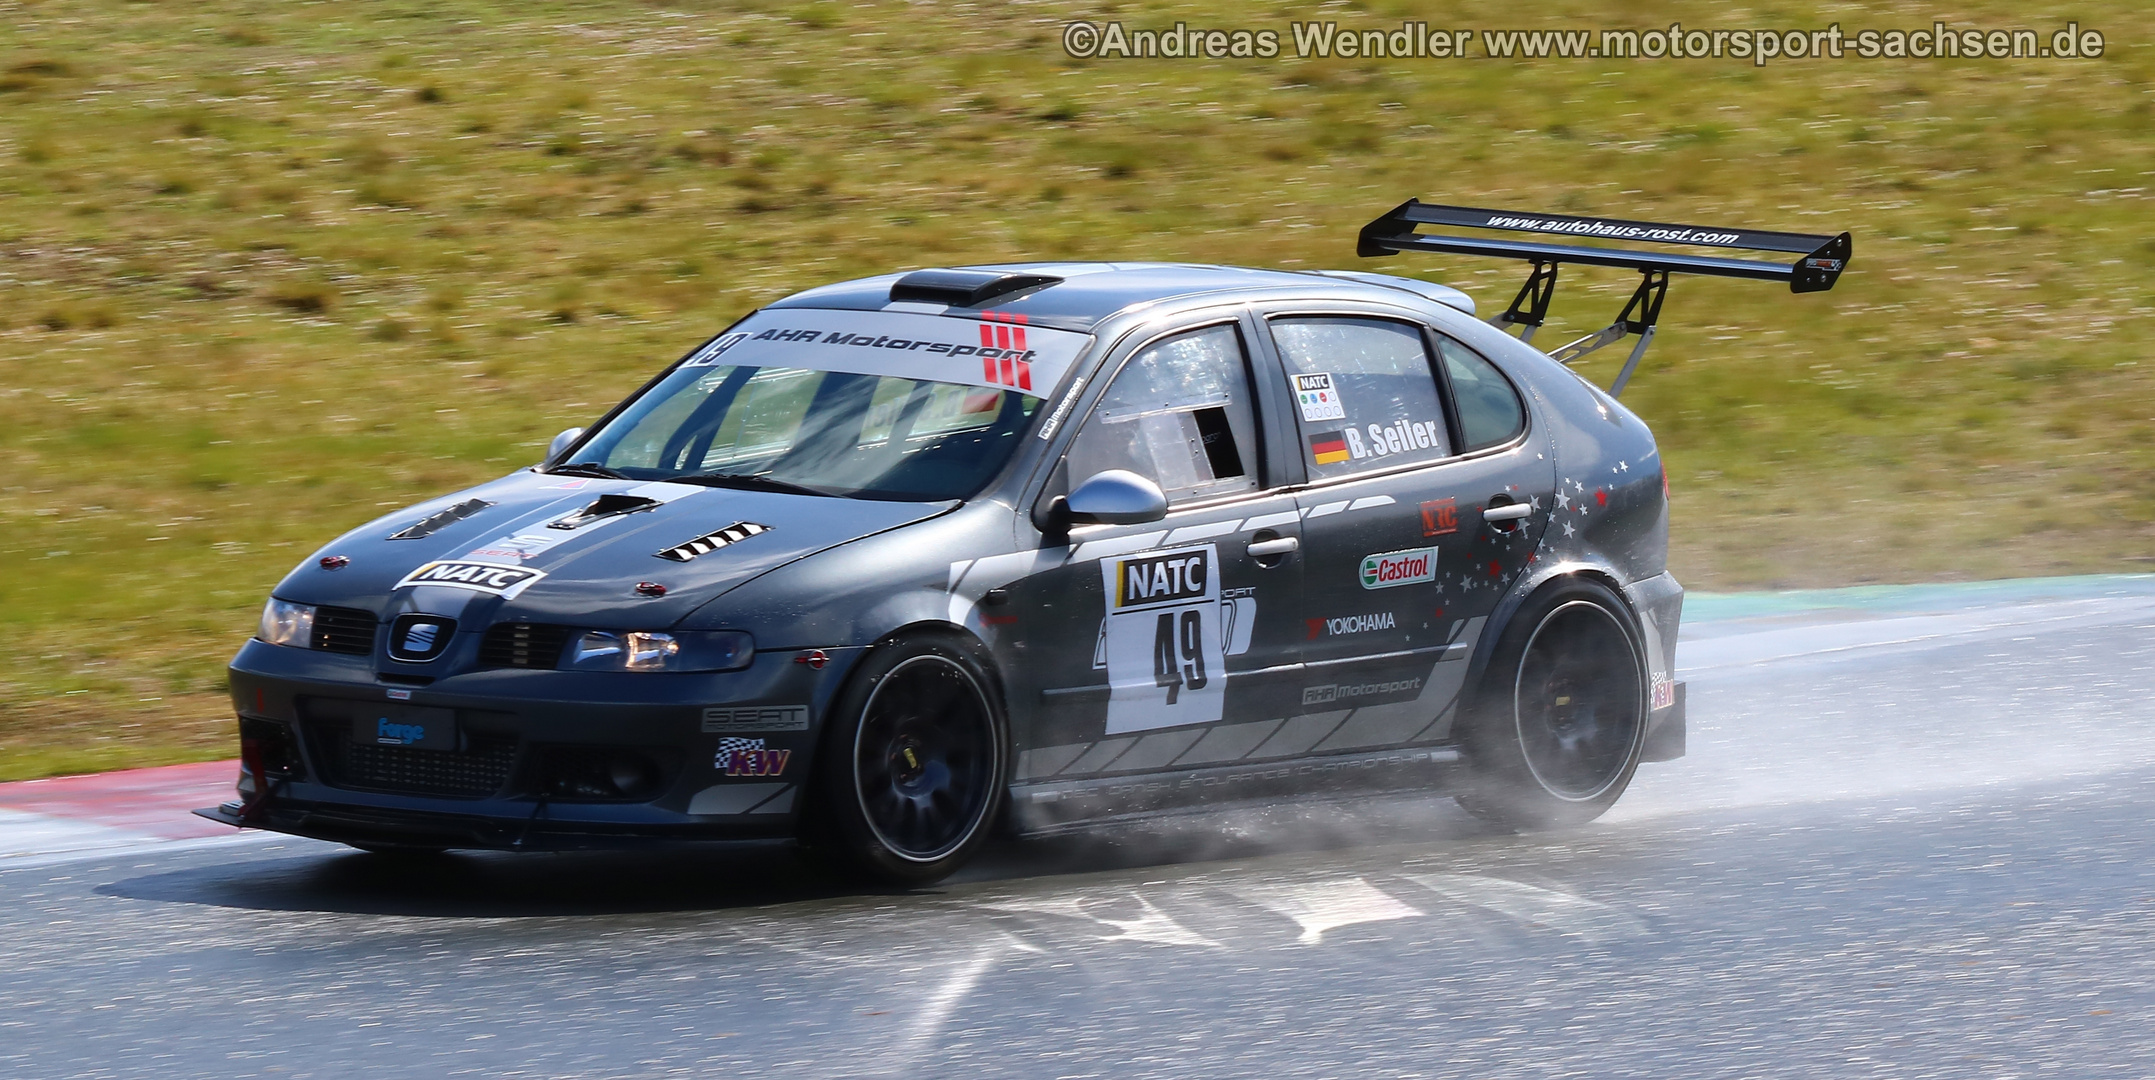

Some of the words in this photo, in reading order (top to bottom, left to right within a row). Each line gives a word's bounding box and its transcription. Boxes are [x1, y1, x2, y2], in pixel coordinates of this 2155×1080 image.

[1486, 214, 1740, 245] www.autohaus-rost.com
[751, 328, 822, 343] AHR
[821, 332, 1038, 364] Motorsport
[1299, 375, 1329, 390] NATC
[1344, 418, 1439, 460] B.Seiler
[423, 563, 524, 588] NATC
[1128, 556, 1202, 601] NATC
[1377, 554, 1429, 583] Castrol
[1326, 612, 1396, 636] YOKOHAMA
[1153, 609, 1208, 706] 49
[706, 708, 806, 723] SEAT
[725, 749, 792, 777] KW
